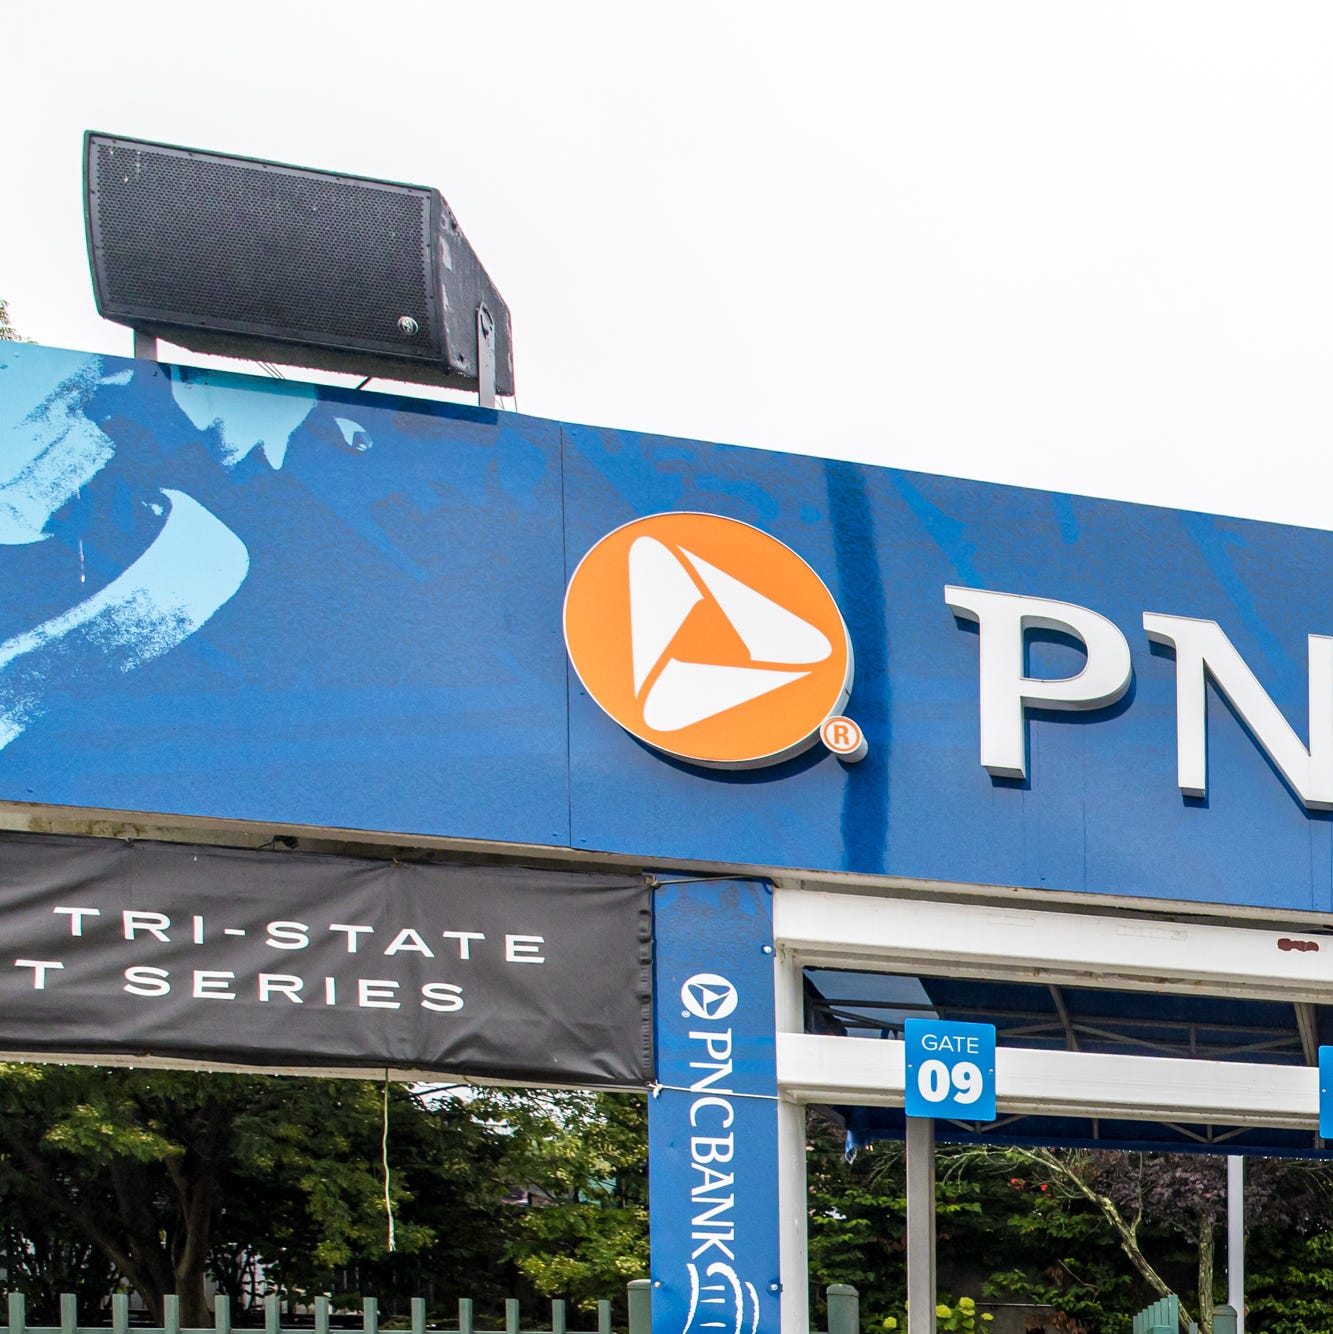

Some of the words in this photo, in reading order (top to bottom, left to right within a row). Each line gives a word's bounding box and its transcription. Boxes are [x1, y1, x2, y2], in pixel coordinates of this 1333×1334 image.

[53, 906, 546, 964] TRI-STATE
[125, 967, 465, 1012] SERIES
[921, 1034, 980, 1053] GATE
[689, 1029, 733, 1130] PNC
[917, 1059, 983, 1105] 09
[690, 1135, 736, 1260] BANK
